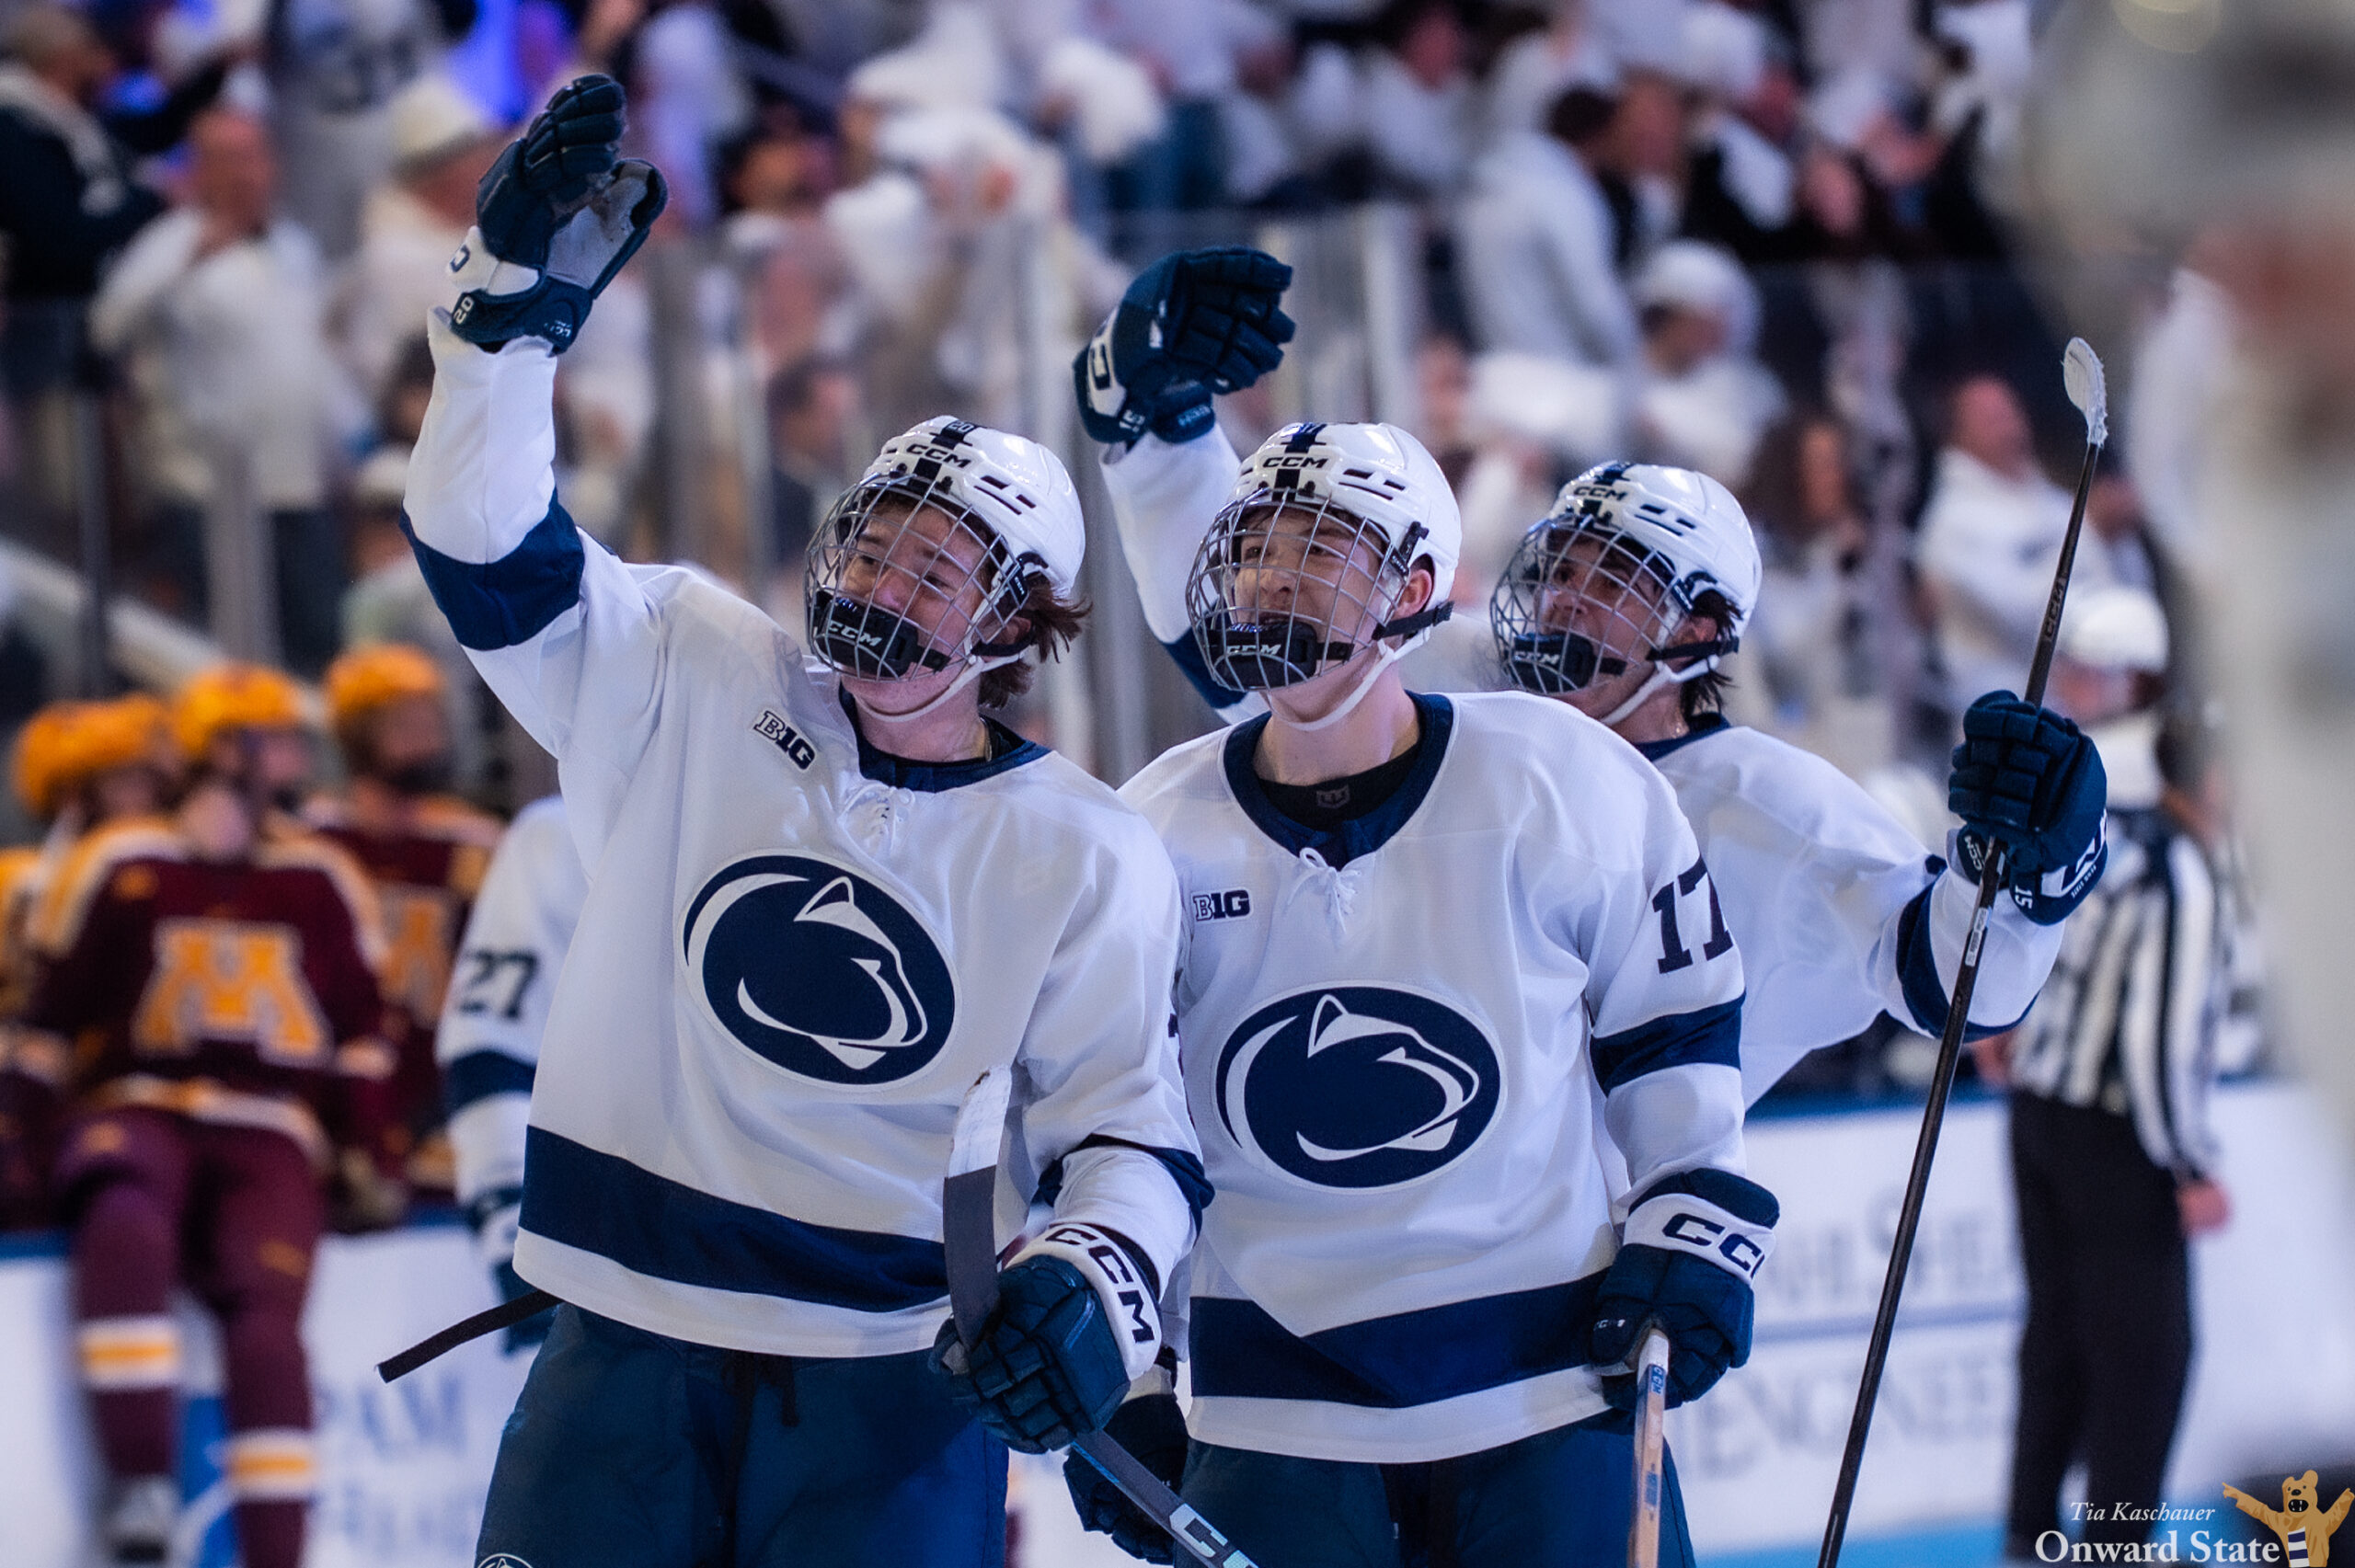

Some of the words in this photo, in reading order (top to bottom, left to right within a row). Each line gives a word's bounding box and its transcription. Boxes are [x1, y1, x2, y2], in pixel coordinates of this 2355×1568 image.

[453, 295, 475, 325] 20
[948, 420, 976, 433] 20
[905, 443, 972, 468] CCM
[1261, 456, 1329, 469] CCM
[1573, 486, 1628, 501] CCM
[827, 619, 883, 647] CCM
[1225, 644, 1282, 656] CCM
[2015, 885, 2034, 910] 15
[1652, 853, 1734, 975] 17
[457, 949, 539, 1021] 27
[1045, 1226, 1156, 1345] CCM
